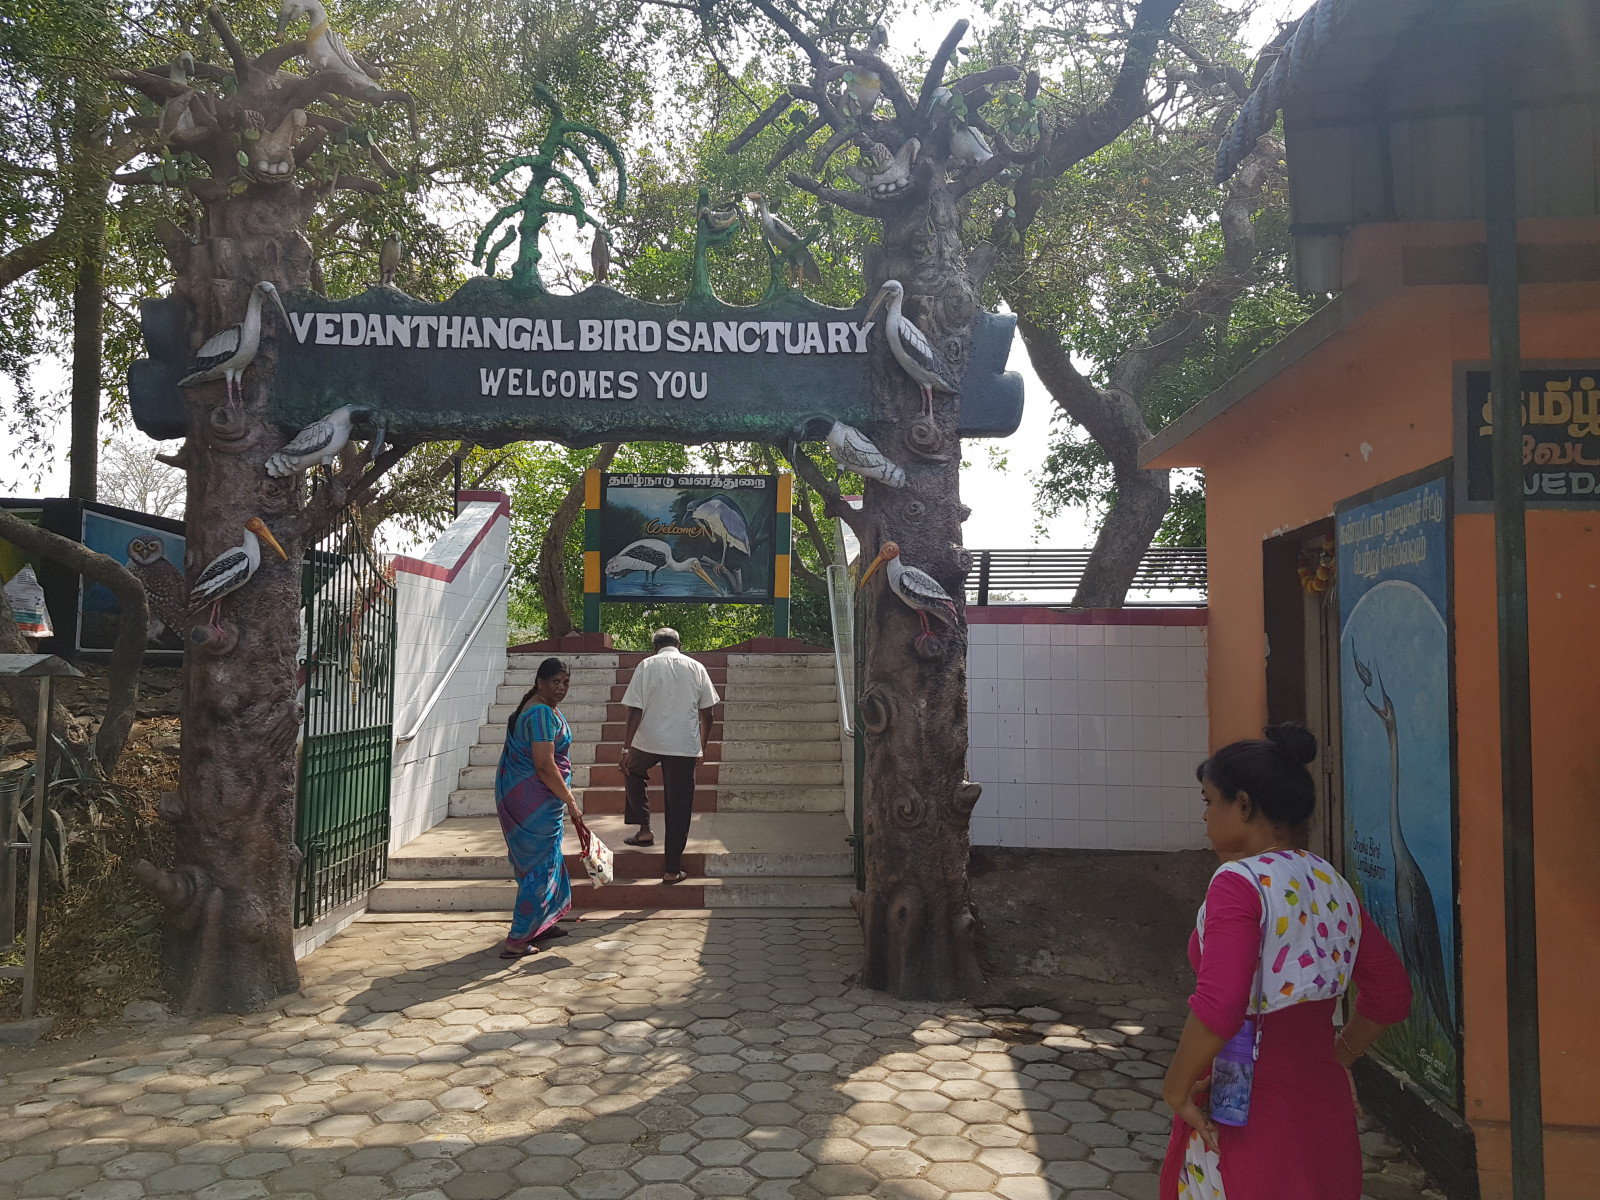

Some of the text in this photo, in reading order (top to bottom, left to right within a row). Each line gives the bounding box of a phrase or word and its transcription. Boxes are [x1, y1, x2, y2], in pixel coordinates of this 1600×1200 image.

[290, 312, 874, 354] VEDANTHANGAL BIRD SANCTUARY
[481, 367, 708, 400] WELCOMES YOU
[608, 474, 766, 489] தமிழ்நாடு வனத்துறை
[646, 518, 704, 537] Welcome
[1353, 830, 1381, 859] Snake Bird
